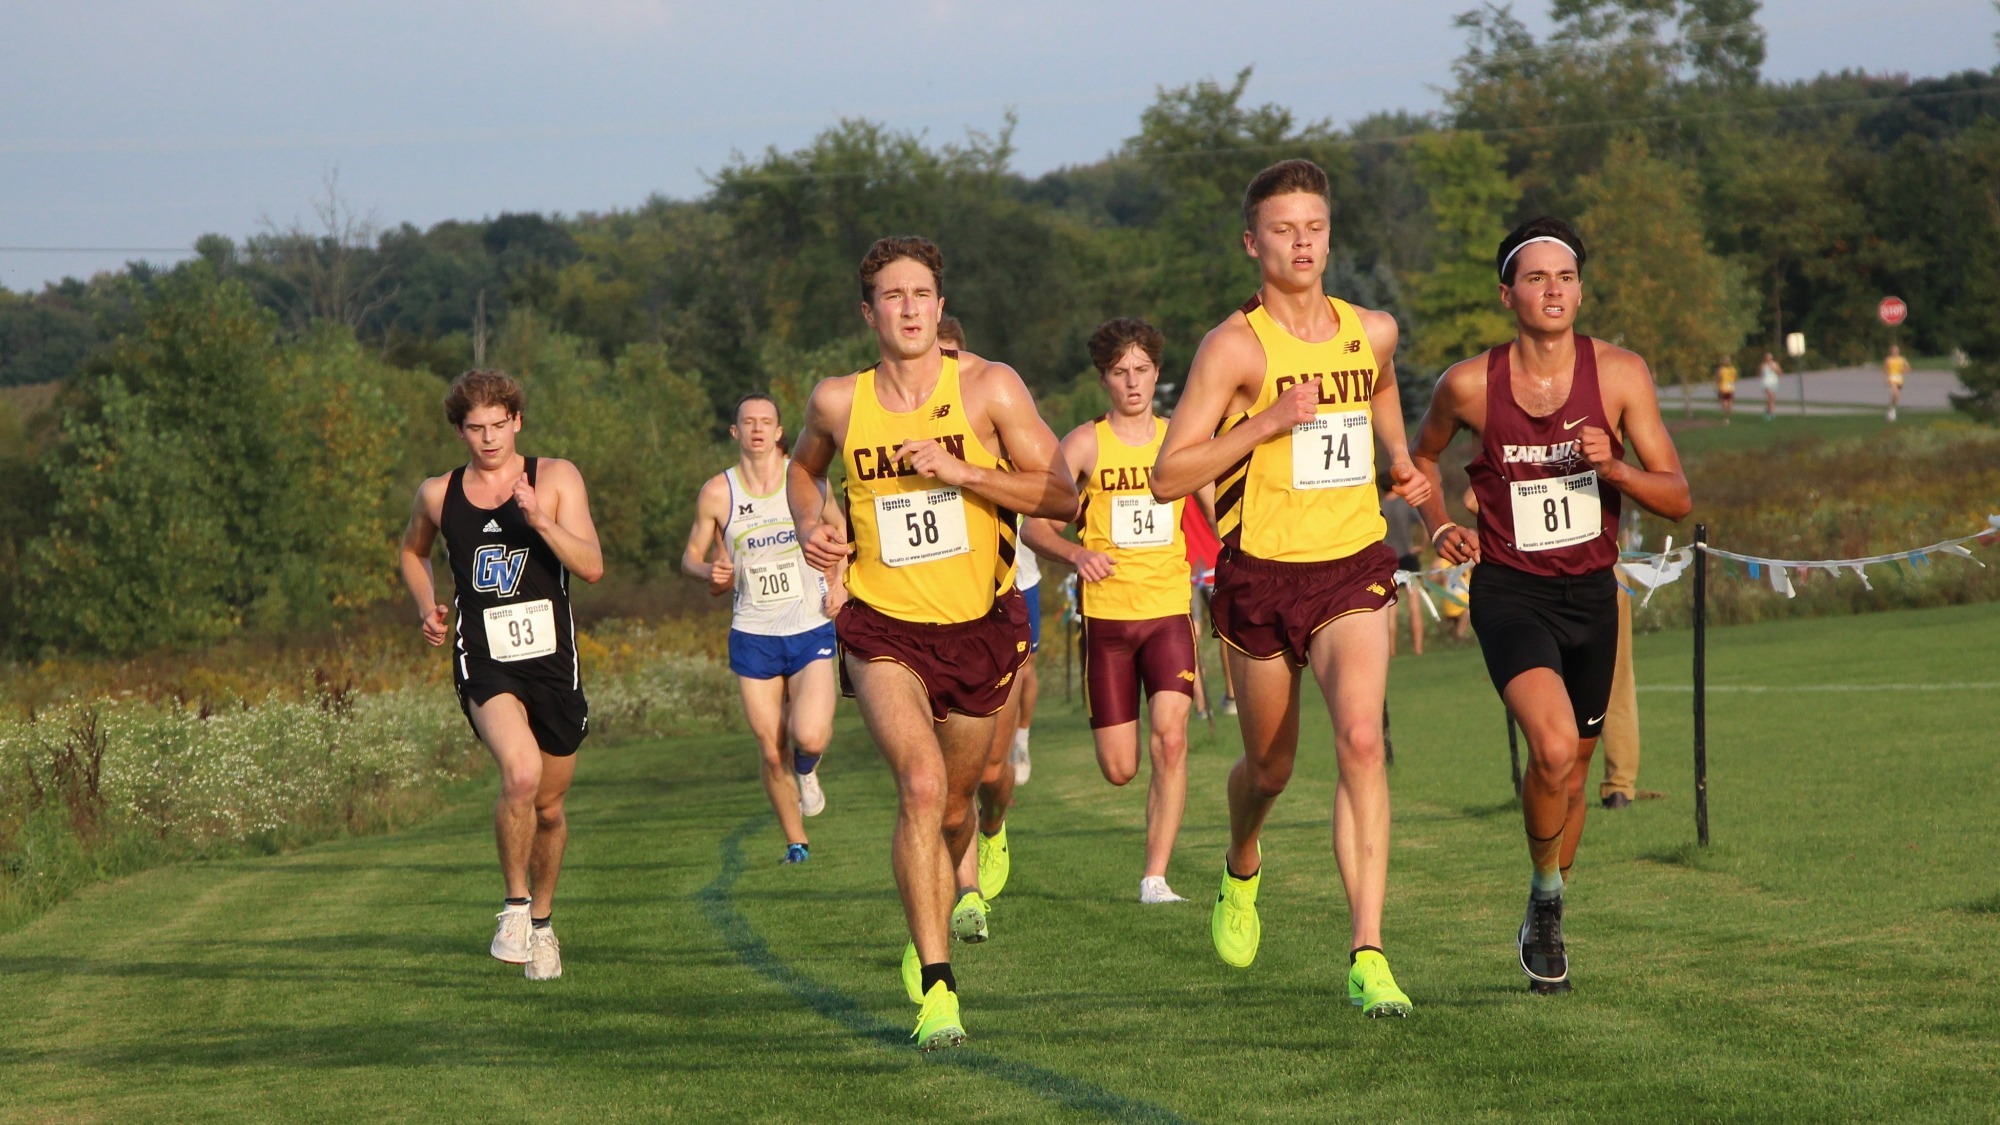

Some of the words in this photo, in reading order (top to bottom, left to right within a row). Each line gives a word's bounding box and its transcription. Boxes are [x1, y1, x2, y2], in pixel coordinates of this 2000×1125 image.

[1880, 304, 1905, 316] STOP
[1343, 415, 1367, 428] ignite
[853, 434, 967, 481] CALN
[1321, 433, 1351, 470] 74
[1517, 483, 1548, 497] ignite
[1564, 475, 1593, 491] ignite
[738, 503, 754, 515] M
[880, 498, 911, 511] ignite
[927, 490, 958, 505] ignite
[1133, 509, 1154, 535] 54
[1543, 496, 1571, 532] 81
[905, 510, 939, 547] 58
[472, 544, 529, 598] GV
[759, 572, 789, 596] 208
[525, 603, 549, 615] ignite
[508, 618, 535, 647] 93
